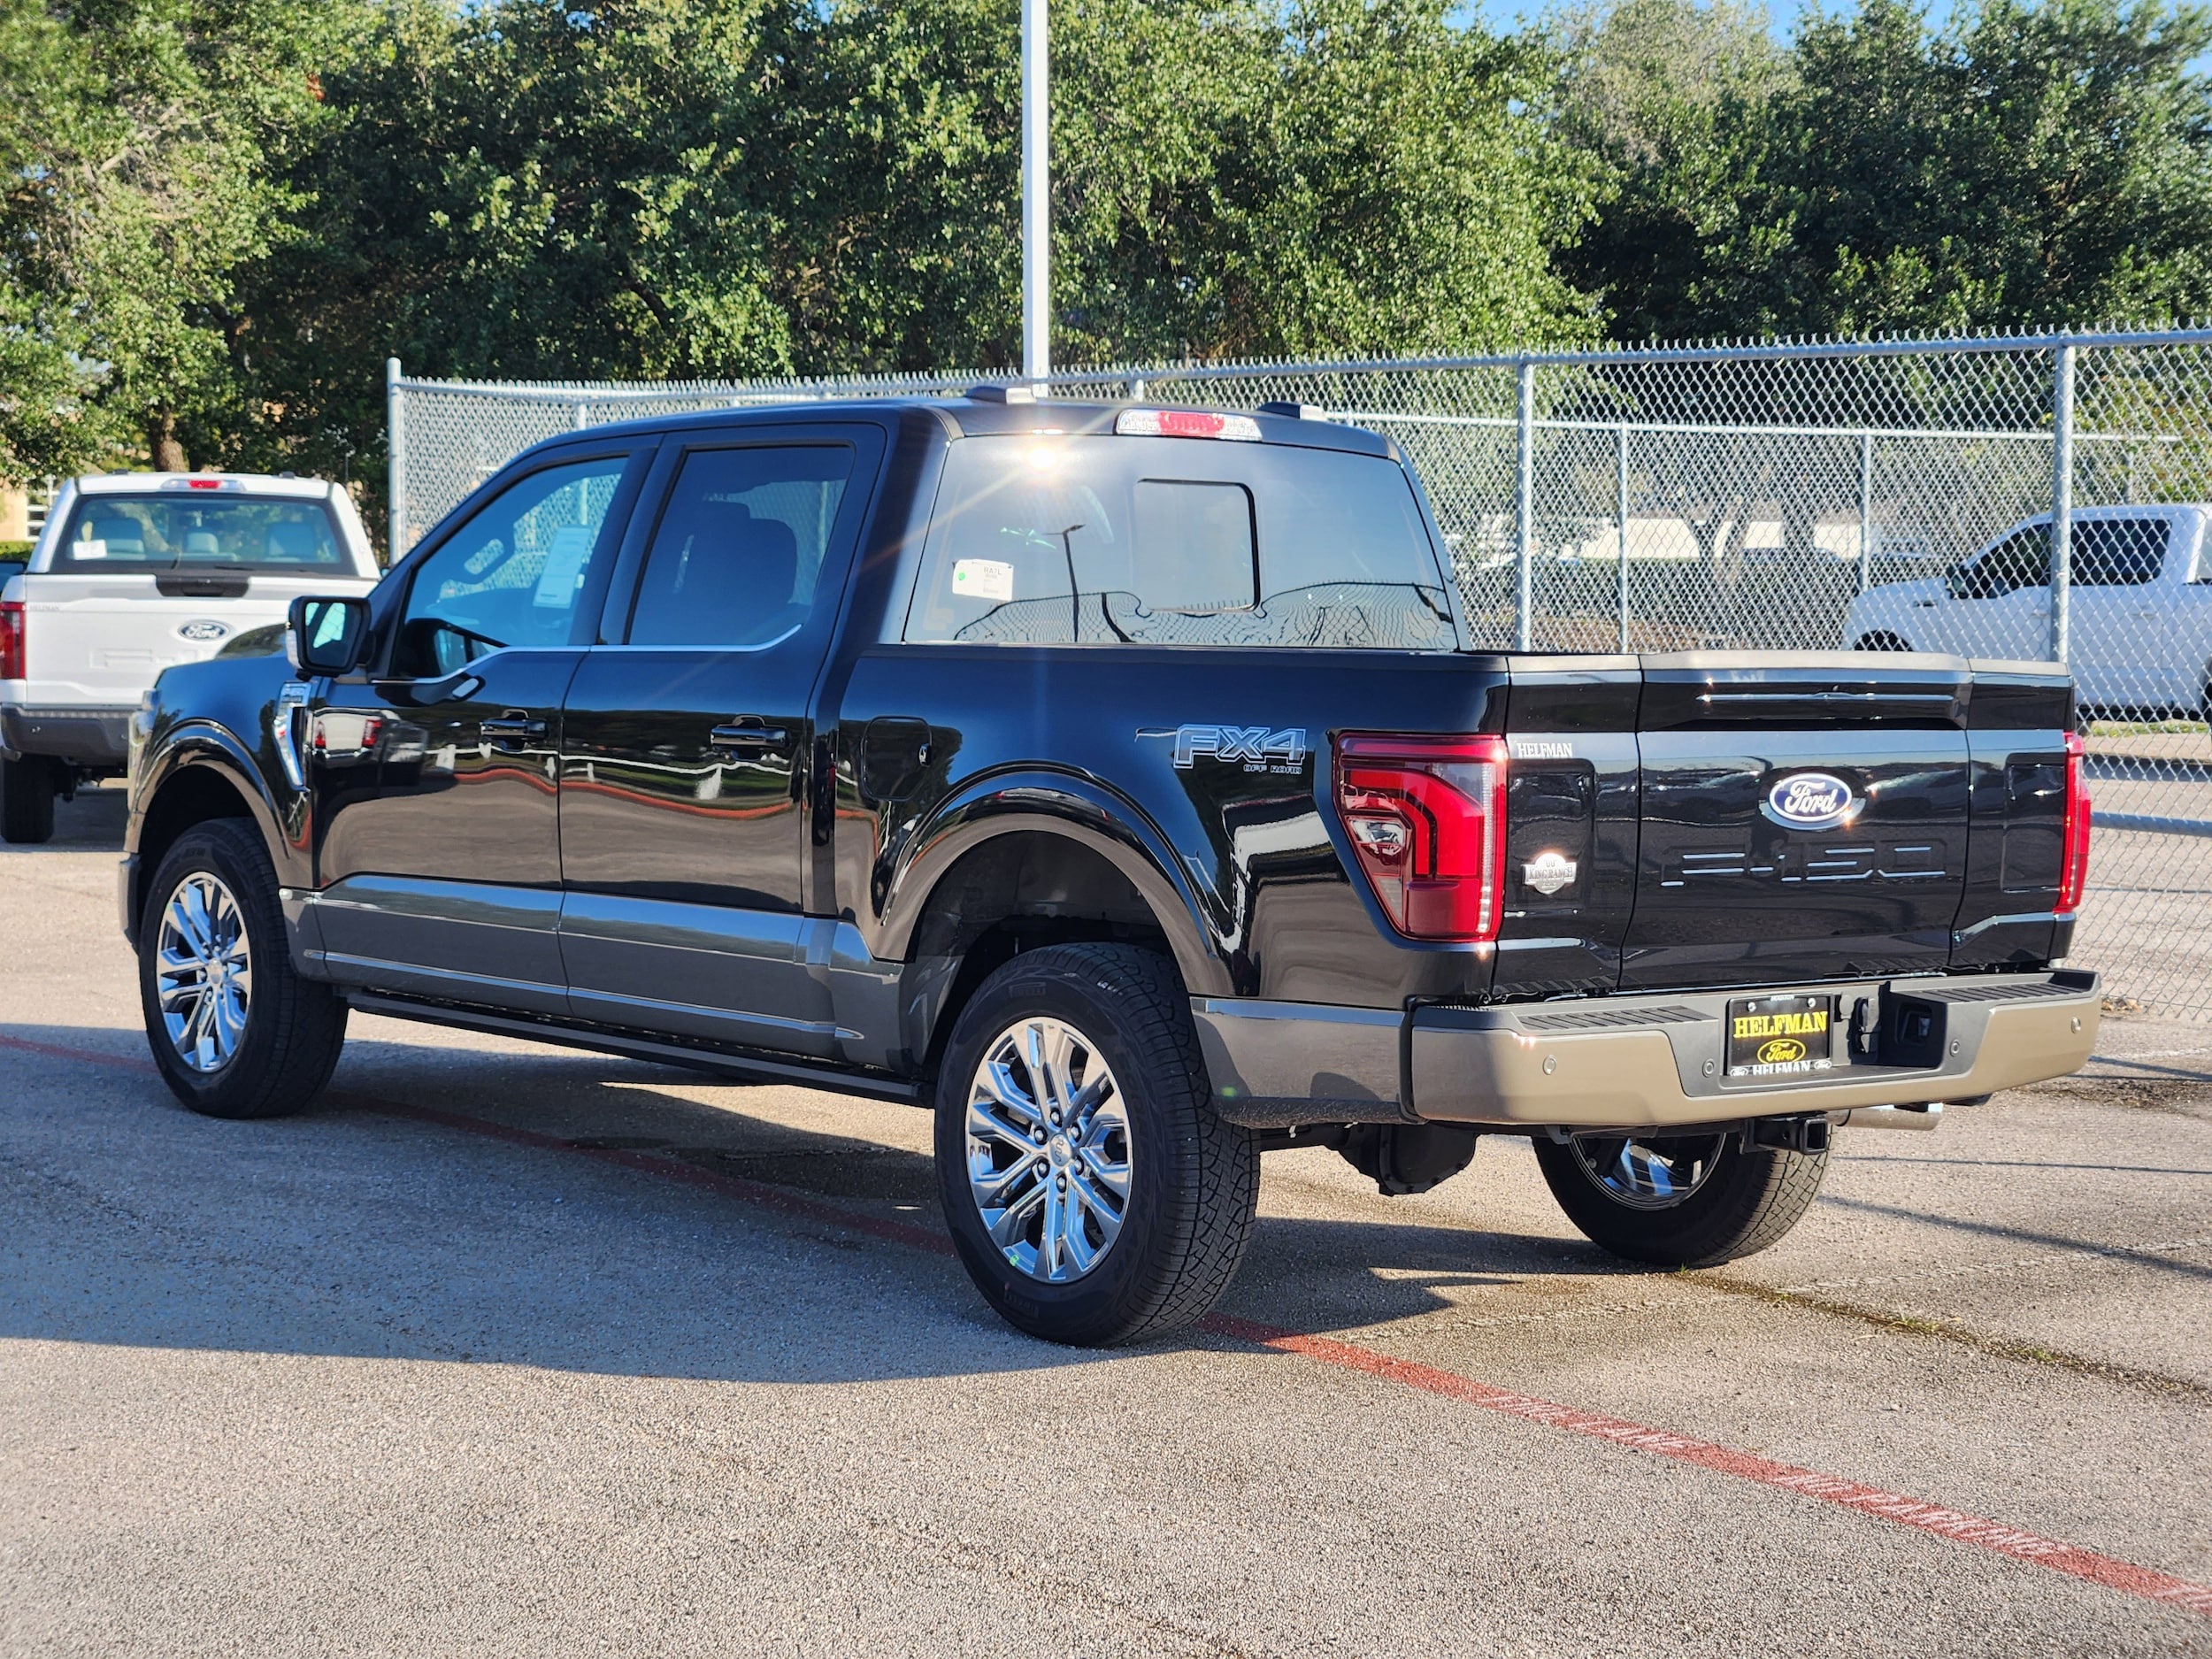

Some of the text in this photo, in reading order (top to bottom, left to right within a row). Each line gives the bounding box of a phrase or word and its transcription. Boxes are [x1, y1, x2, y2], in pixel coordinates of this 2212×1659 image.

[186, 623, 222, 639] Ford
[1173, 724, 1306, 769] FX4
[1517, 742, 1573, 758] HELFMAN
[1243, 764, 1302, 775] OFF ROAD
[1784, 780, 1838, 814] Ford
[1733, 1011, 1828, 1038] HELFMAN
[1766, 1042, 1798, 1062] Ford
[1752, 1061, 1811, 1075] HELFMAN
